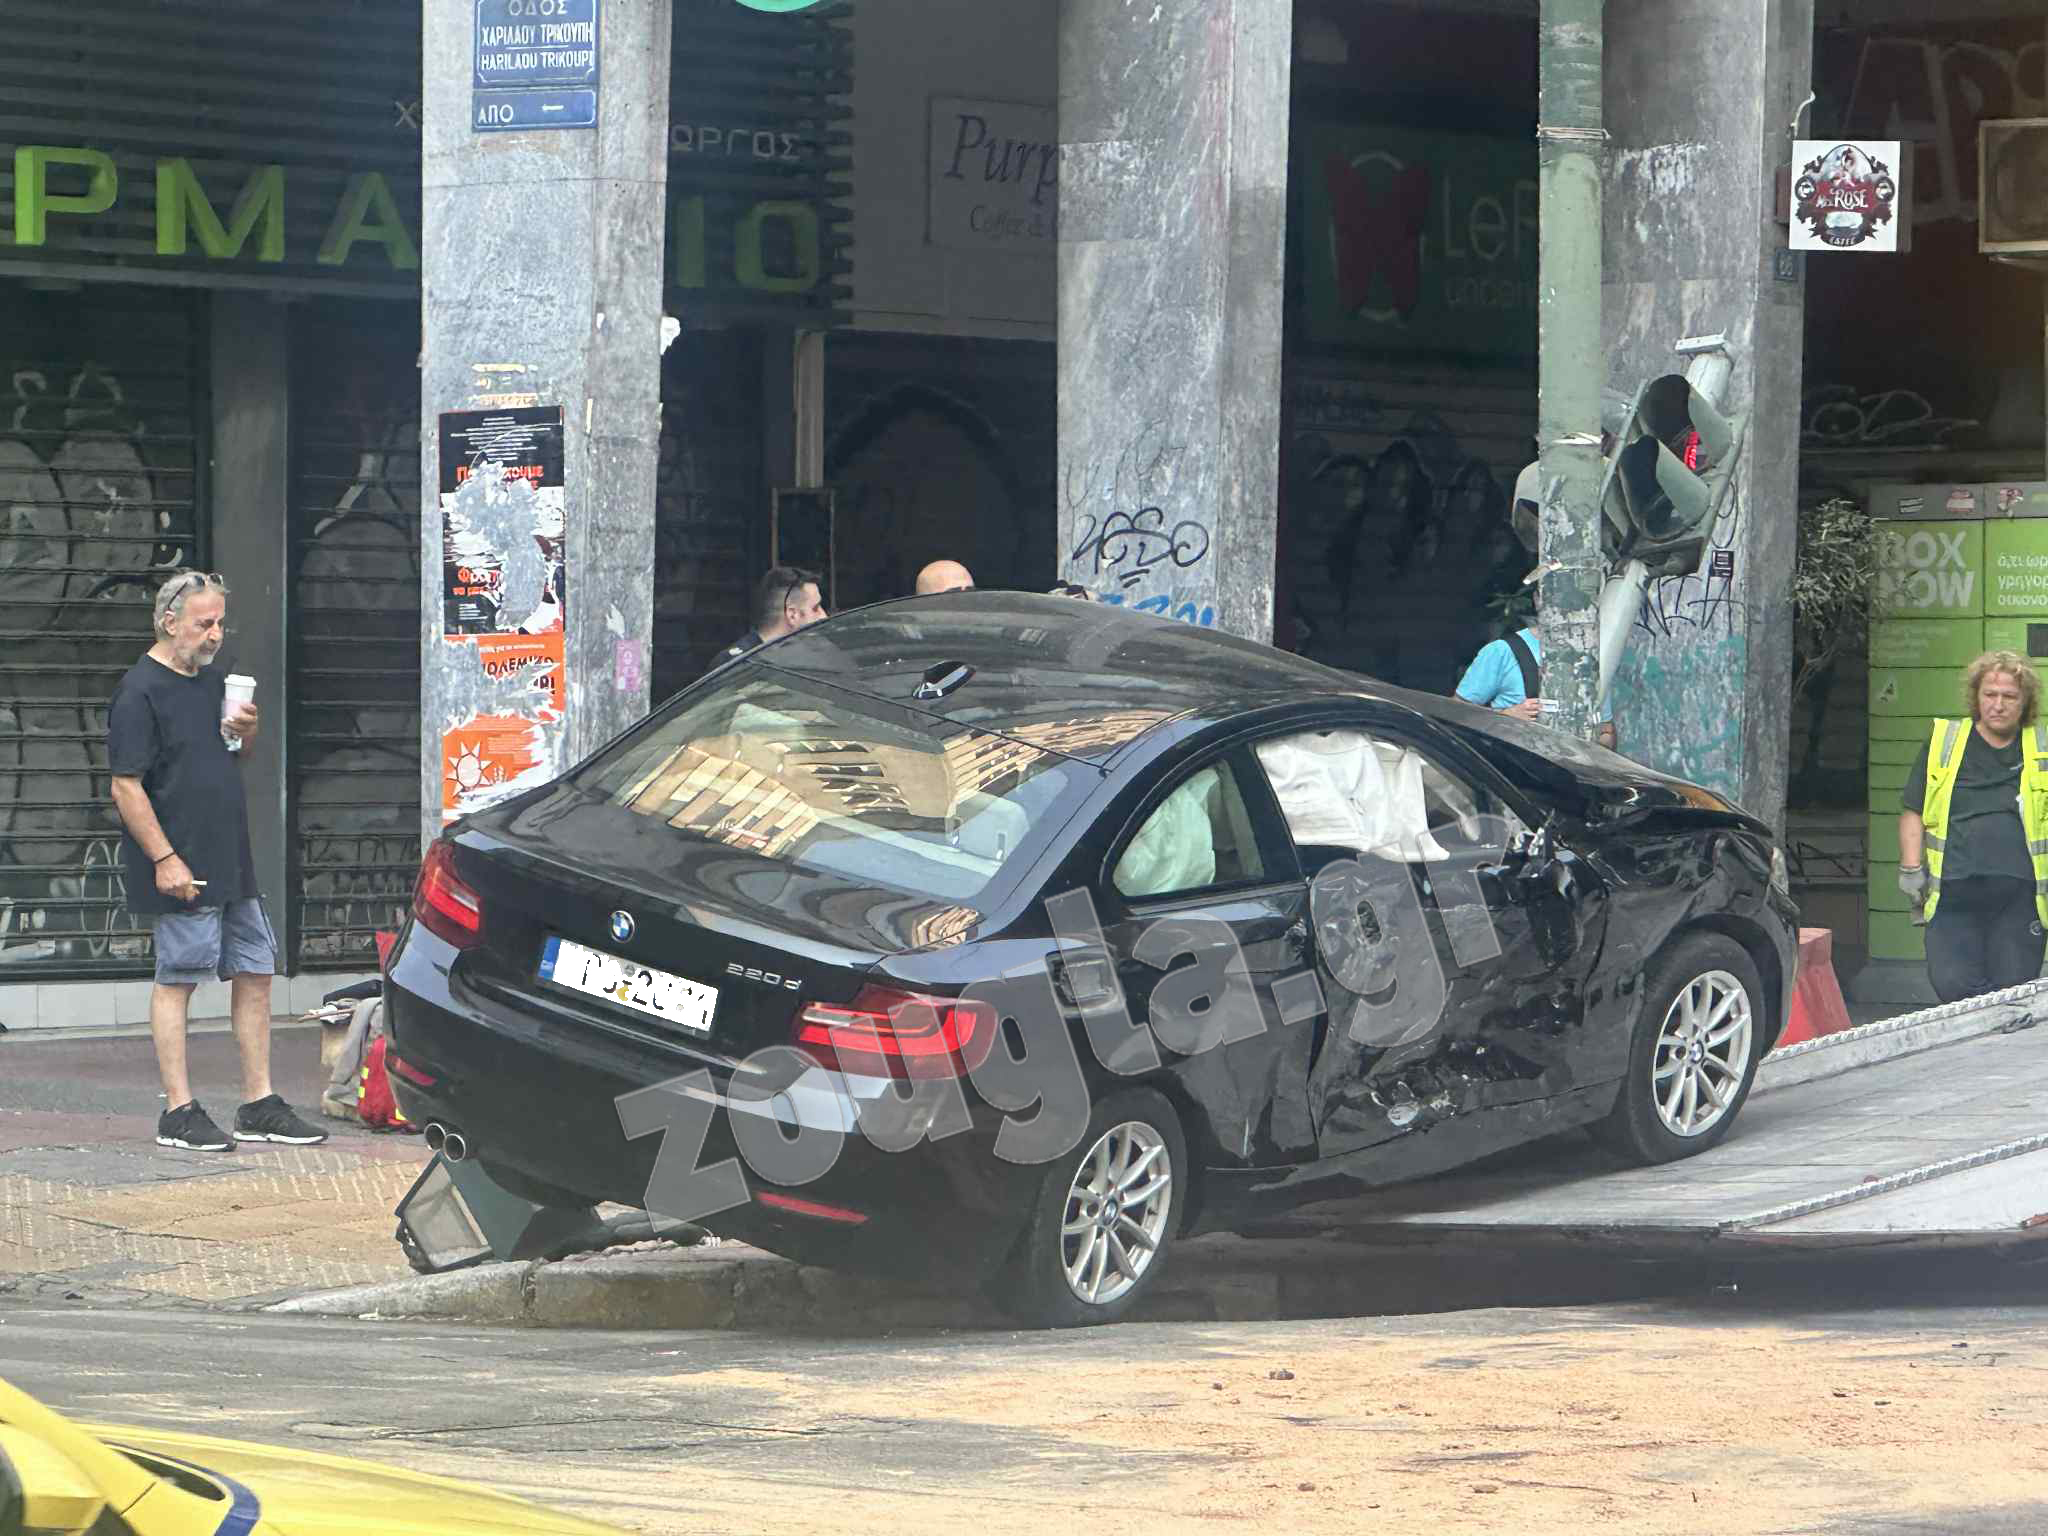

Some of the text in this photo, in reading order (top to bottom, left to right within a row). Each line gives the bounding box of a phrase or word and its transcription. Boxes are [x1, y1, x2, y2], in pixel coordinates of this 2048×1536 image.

[509, 0, 568, 17] ΟΔΟΣ
[481, 22, 593, 47] ΧΑΡΙΛΑΟΥ ΤΡΙΚΟΥΠΗ
[481, 50, 594, 71] HARILAOU TRIKOUPI
[477, 104, 514, 124] ΑΠΟ
[669, 122, 802, 161] ΩΡΓΟΣ
[943, 113, 1058, 205] Purp
[1829, 188, 1869, 211] ROSE
[1879, 531, 1967, 570] BOX
[1879, 571, 1976, 609] NOW
